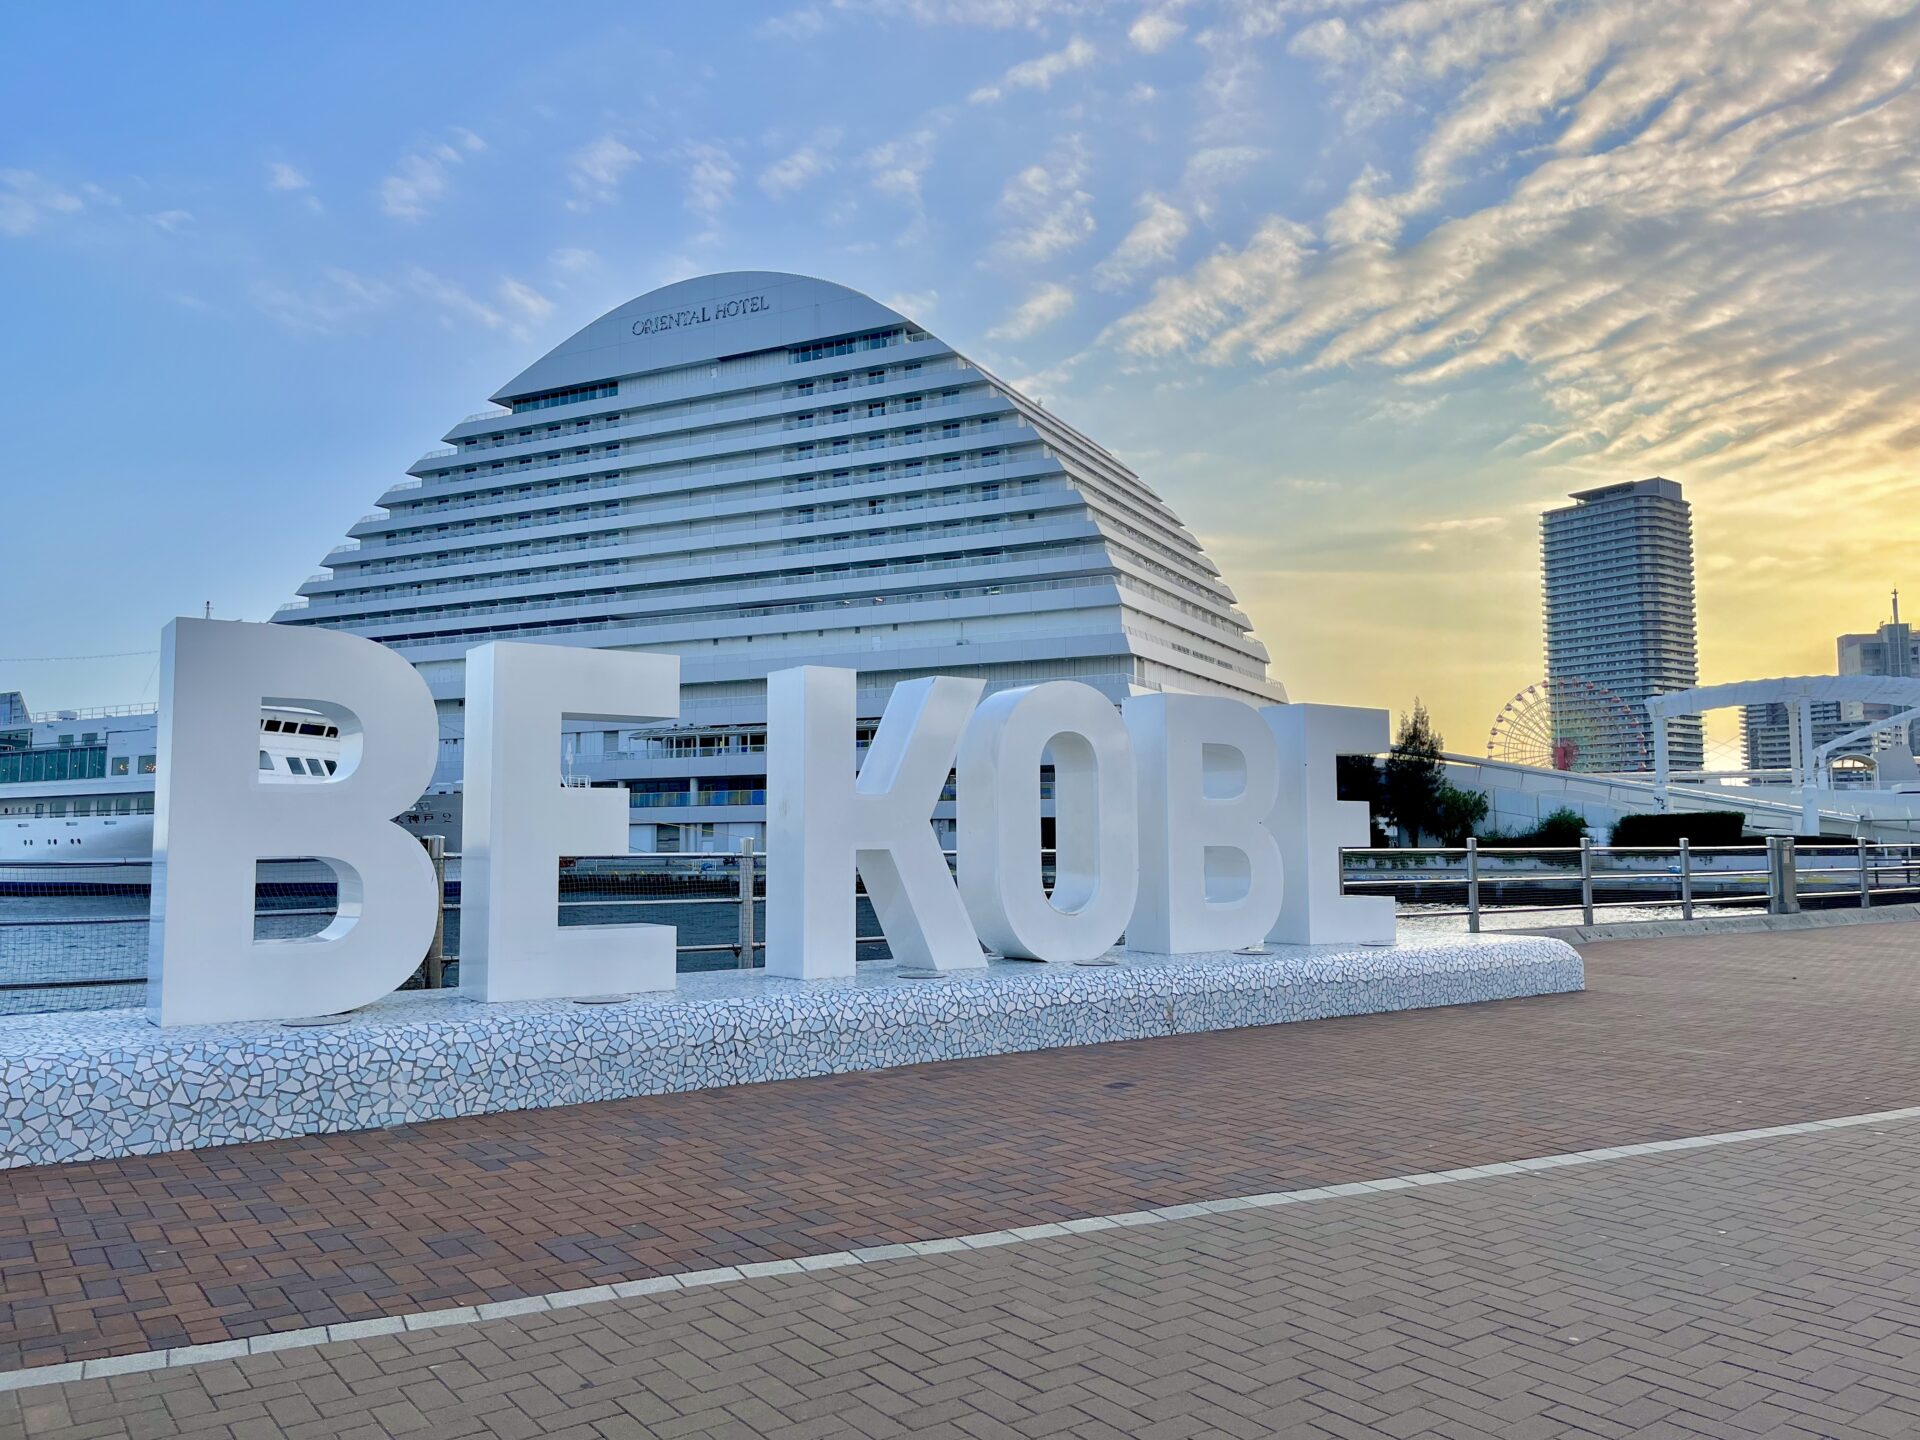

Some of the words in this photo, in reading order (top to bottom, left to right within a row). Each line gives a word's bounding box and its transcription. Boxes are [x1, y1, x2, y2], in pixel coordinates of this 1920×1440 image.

[632, 307, 711, 336] ORIENTAL
[715, 296, 770, 320] HOTEL
[148, 617, 680, 1027] BE
[766, 665, 1396, 979] KOBE
